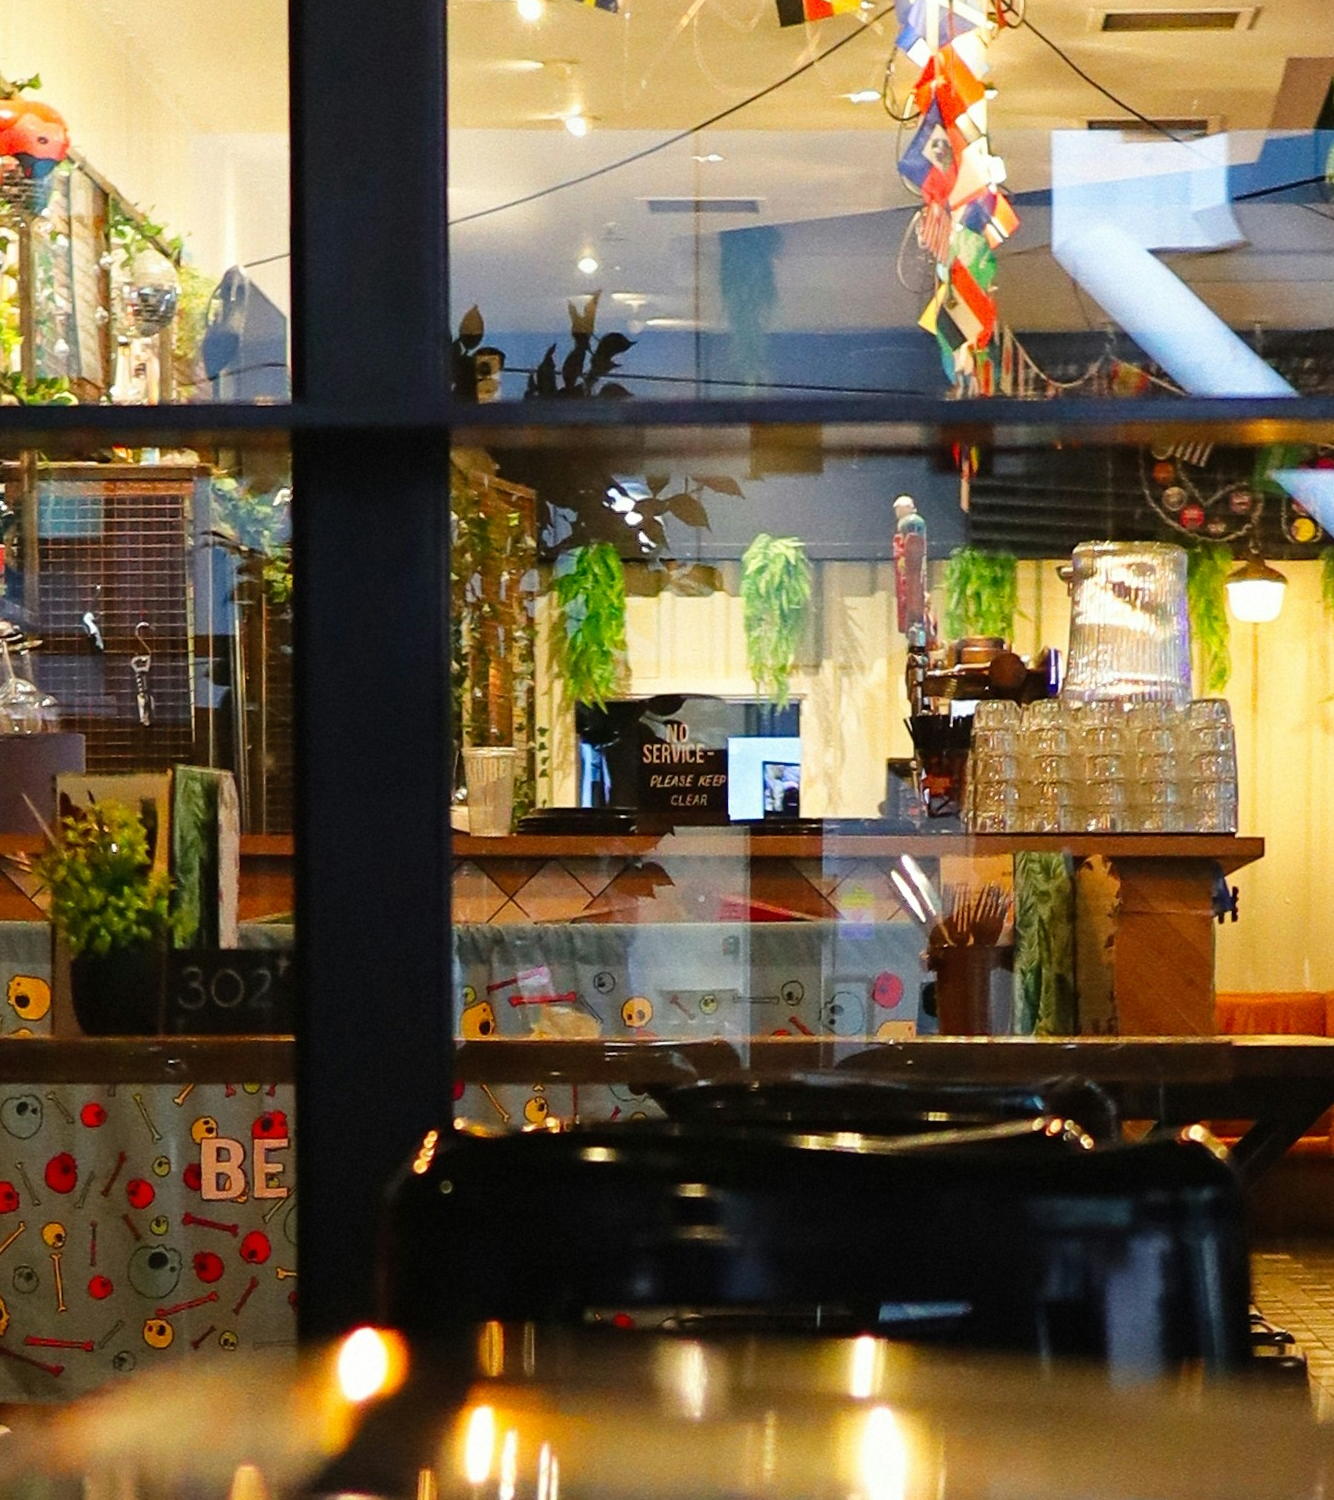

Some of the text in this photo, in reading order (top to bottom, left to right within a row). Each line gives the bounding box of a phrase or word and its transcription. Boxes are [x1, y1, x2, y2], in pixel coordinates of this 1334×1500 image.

[667, 724, 689, 743] NO
[650, 775, 727, 787] PLEASE KEEP
[670, 794, 708, 806] CLEAR
